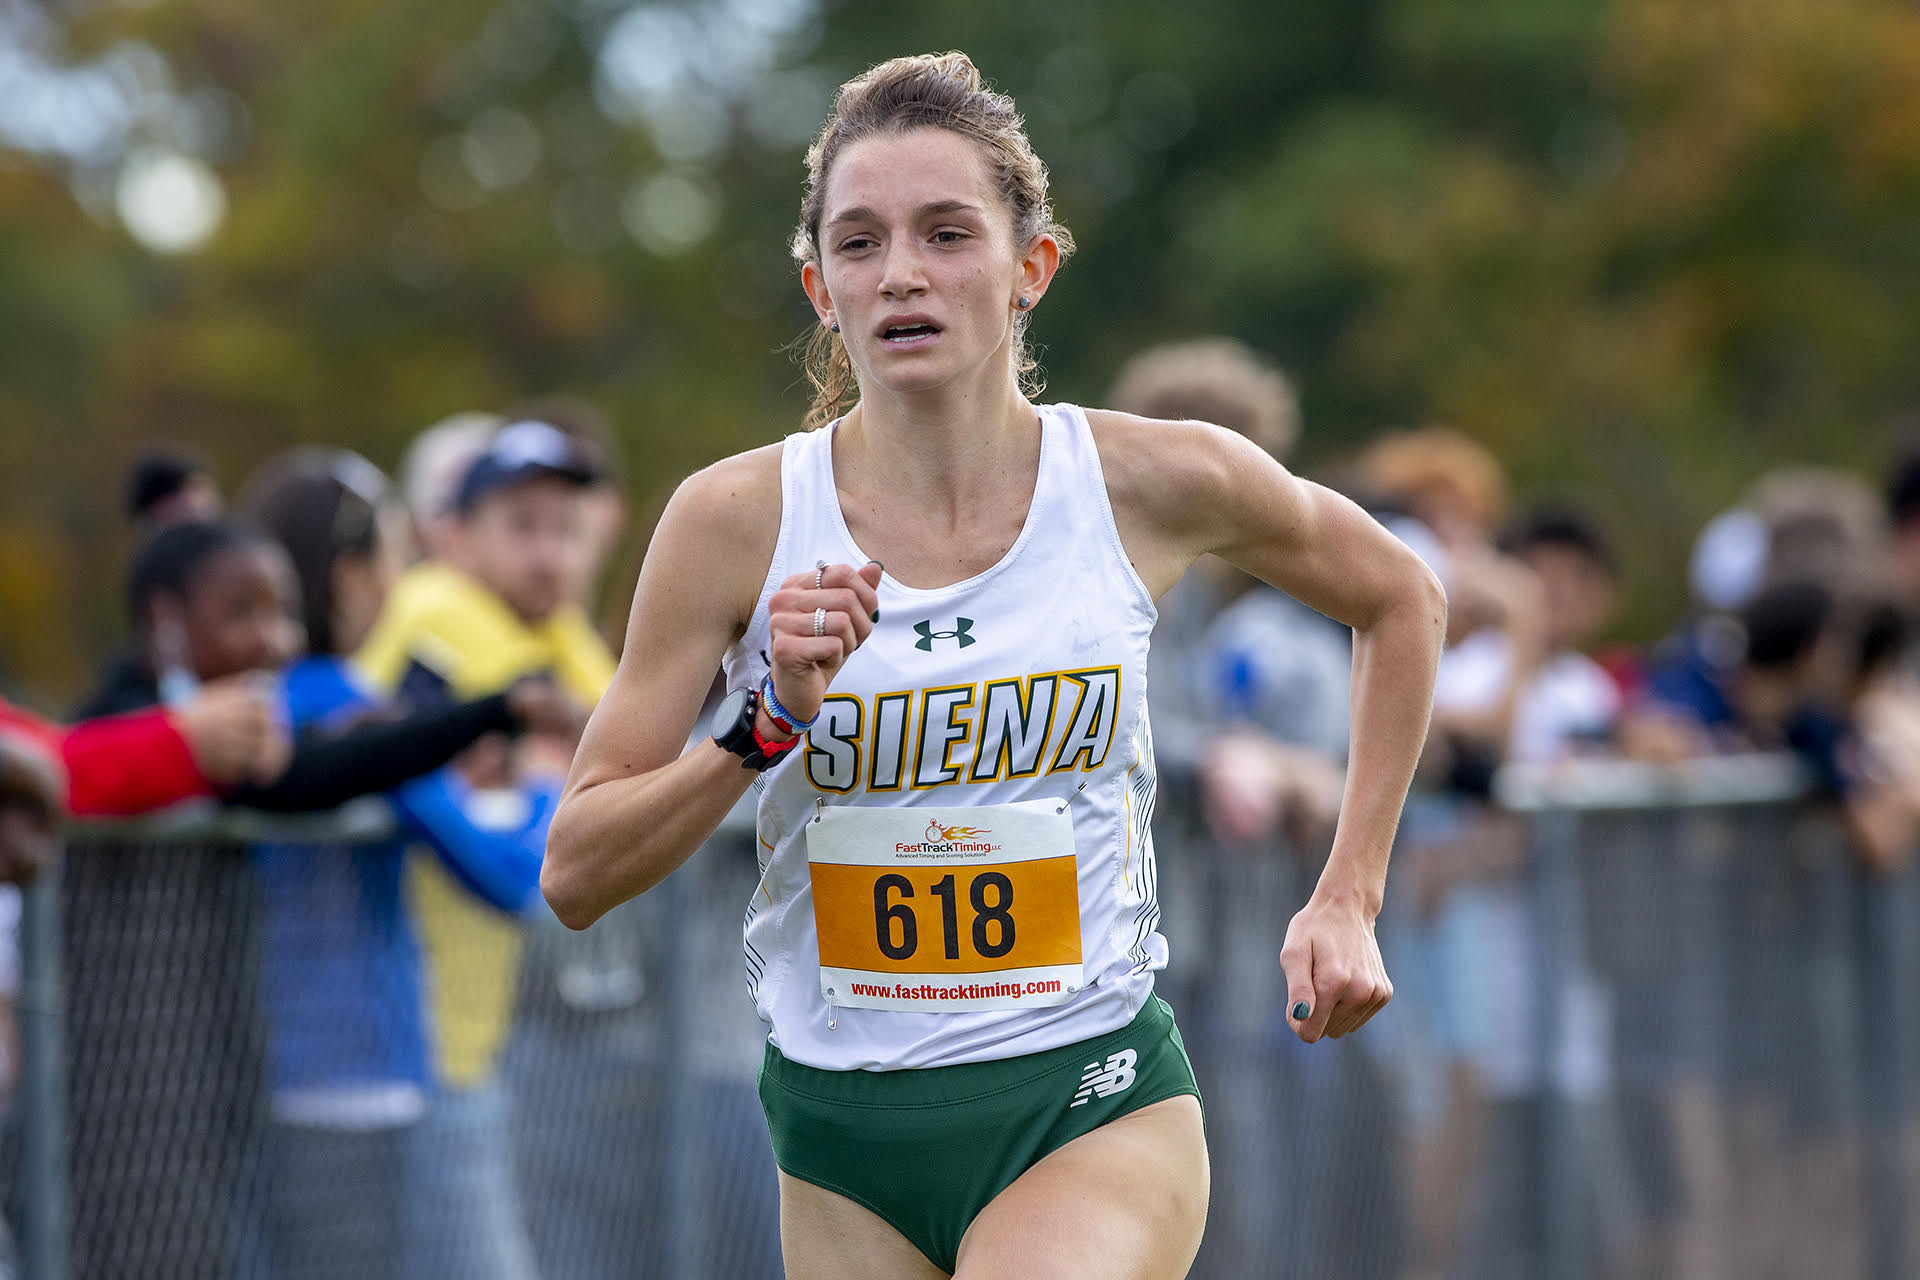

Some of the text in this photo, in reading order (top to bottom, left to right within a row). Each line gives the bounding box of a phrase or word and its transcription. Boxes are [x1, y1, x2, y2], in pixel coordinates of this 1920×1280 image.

[803, 664, 1122, 795] SIENA
[873, 871, 1016, 961] 618
[851, 979, 1061, 1000] www.fasttracktiming.com
